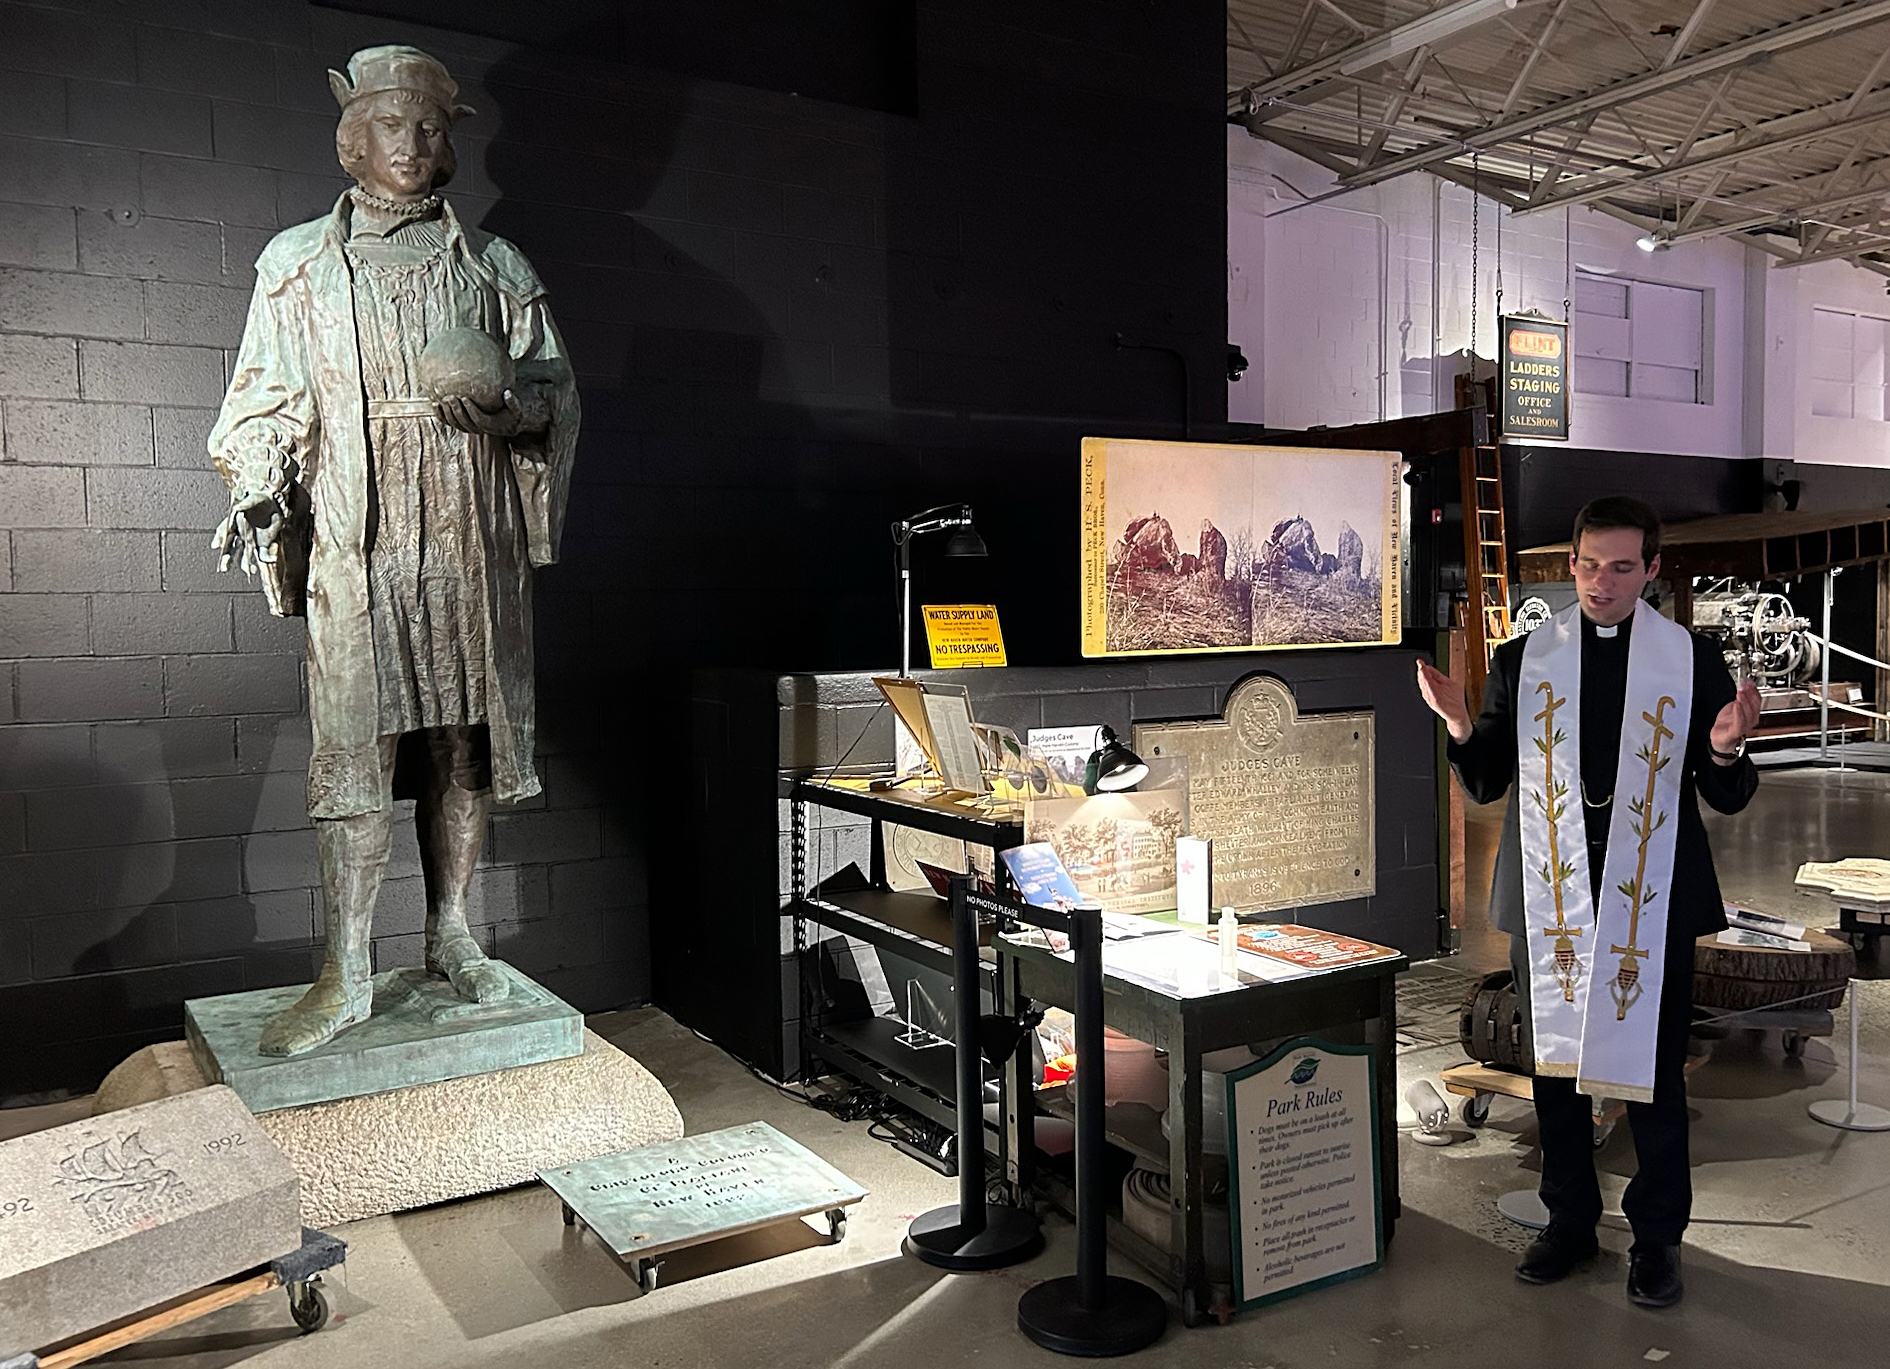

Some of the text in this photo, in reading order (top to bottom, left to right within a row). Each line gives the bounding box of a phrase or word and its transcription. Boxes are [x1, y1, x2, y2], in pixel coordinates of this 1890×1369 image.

[1513, 335, 1555, 351] FLINT
[1510, 362, 1560, 377] LADDERS
[1510, 378, 1560, 394] STAGING
[1518, 396, 1551, 408] OFFICE
[1510, 415, 1558, 428] SALESROOM
[1085, 455, 1093, 494] PECK,
[1392, 519, 1398, 527] of
[1086, 538, 1093, 552] by
[1390, 532, 1398, 549] New
[1390, 555, 1398, 579] Haven
[929, 610, 994, 620] WATER SUPPLY LAND
[936, 644, 999, 654] NO TRESPASSING
[1222, 756, 1300, 772] JUDGES CAVE
[1215, 774, 1256, 786] FIFTEENTH
[1279, 771, 1294, 780] AND
[1297, 770, 1310, 778] FOR
[1314, 768, 1332, 777] SOME
[1334, 765, 1358, 775] WEEKS
[1211, 787, 1244, 799] EDWARD
[1244, 784, 1280, 796] WHALLEY
[1284, 782, 1298, 791] AND
[1302, 782, 1313, 790] HIS
[1221, 800, 1260, 812] MEMBERS
[1263, 798, 1272, 807] OF
[1274, 794, 1320, 806] PARLIAMENT
[1324, 790, 1358, 801] GENERAL
[1228, 813, 1250, 823] ARMY
[1253, 812, 1263, 820] OF
[1265, 809, 1280, 820] THE
[1284, 804, 1342, 817] COMMONWEALTH
[1345, 802, 1359, 811] AND
[1228, 825, 1252, 836] DEATH
[1256, 820, 1292, 833] WARRANT
[1294, 820, 1303, 829] OF
[1305, 817, 1324, 828] KING
[1326, 814, 1359, 825] CHARLES
[1214, 838, 1249, 850] SHELTER
[1270, 830, 1322, 843] CONCEALMENT
[1324, 828, 1344, 838] FROM
[1345, 826, 1360, 835] THE
[1256, 848, 1281, 859] AFTER
[1282, 846, 1297, 855] THE
[1298, 840, 1348, 853] RESTORATION
[1232, 867, 1268, 879] TYRANTS
[1279, 860, 1321, 874] OBEDIENCE
[1322, 859, 1333, 868] TO
[1335, 856, 1350, 866] GOD
[1250, 882, 1277, 895] 1896
[967, 895, 1018, 918] NO PHOTOS PLEASE
[1267, 1087, 1343, 1117] Park Rules
[1259, 1126, 1274, 1135] Dogs
[1276, 1122, 1291, 1130] must
[1291, 1118, 1298, 1127] be
[1314, 1112, 1329, 1122] leash
[1338, 1108, 1346, 1116] all
[1278, 1128, 1301, 1140] Owners
[1302, 1125, 1317, 1134] must
[1317, 1121, 1330, 1133] pick
[1340, 1116, 1353, 1126] after
[202, 1134, 247, 1154] 1992
[1259, 1145, 1274, 1155] their
[1259, 1159, 1275, 1170] Park
[1282, 1153, 1303, 1164] closed
[1303, 1149, 1322, 1158] sunset
[1330, 1143, 1350, 1152] sunrise
[1260, 1170, 1279, 1180] unless
[1280, 1164, 1301, 1175] posted
[1332, 1152, 1351, 1162] Police
[1260, 1180, 1274, 1189] take
[1261, 1174, 1355, 1205] No motorized vehicles permitted
[90, 1188, 192, 1228] COLUMBUS 500
[653, 1195, 692, 1208] NEW
[1262, 1222, 1272, 1230] No
[1272, 1219, 1287, 1230] fires
[1287, 1214, 1294, 1223] of
[1295, 1214, 1306, 1222] any
[1307, 1208, 1320, 1218] kind
[1263, 1237, 1280, 1246] Place
[1281, 1232, 1290, 1241] all
[1291, 1229, 1307, 1239] trash
[1315, 1218, 1348, 1231] receptacles
[1263, 1239, 1301, 1256] remove from
[1265, 1258, 1293, 1271] Alcoholic
[1294, 1248, 1323, 1263] beverages
